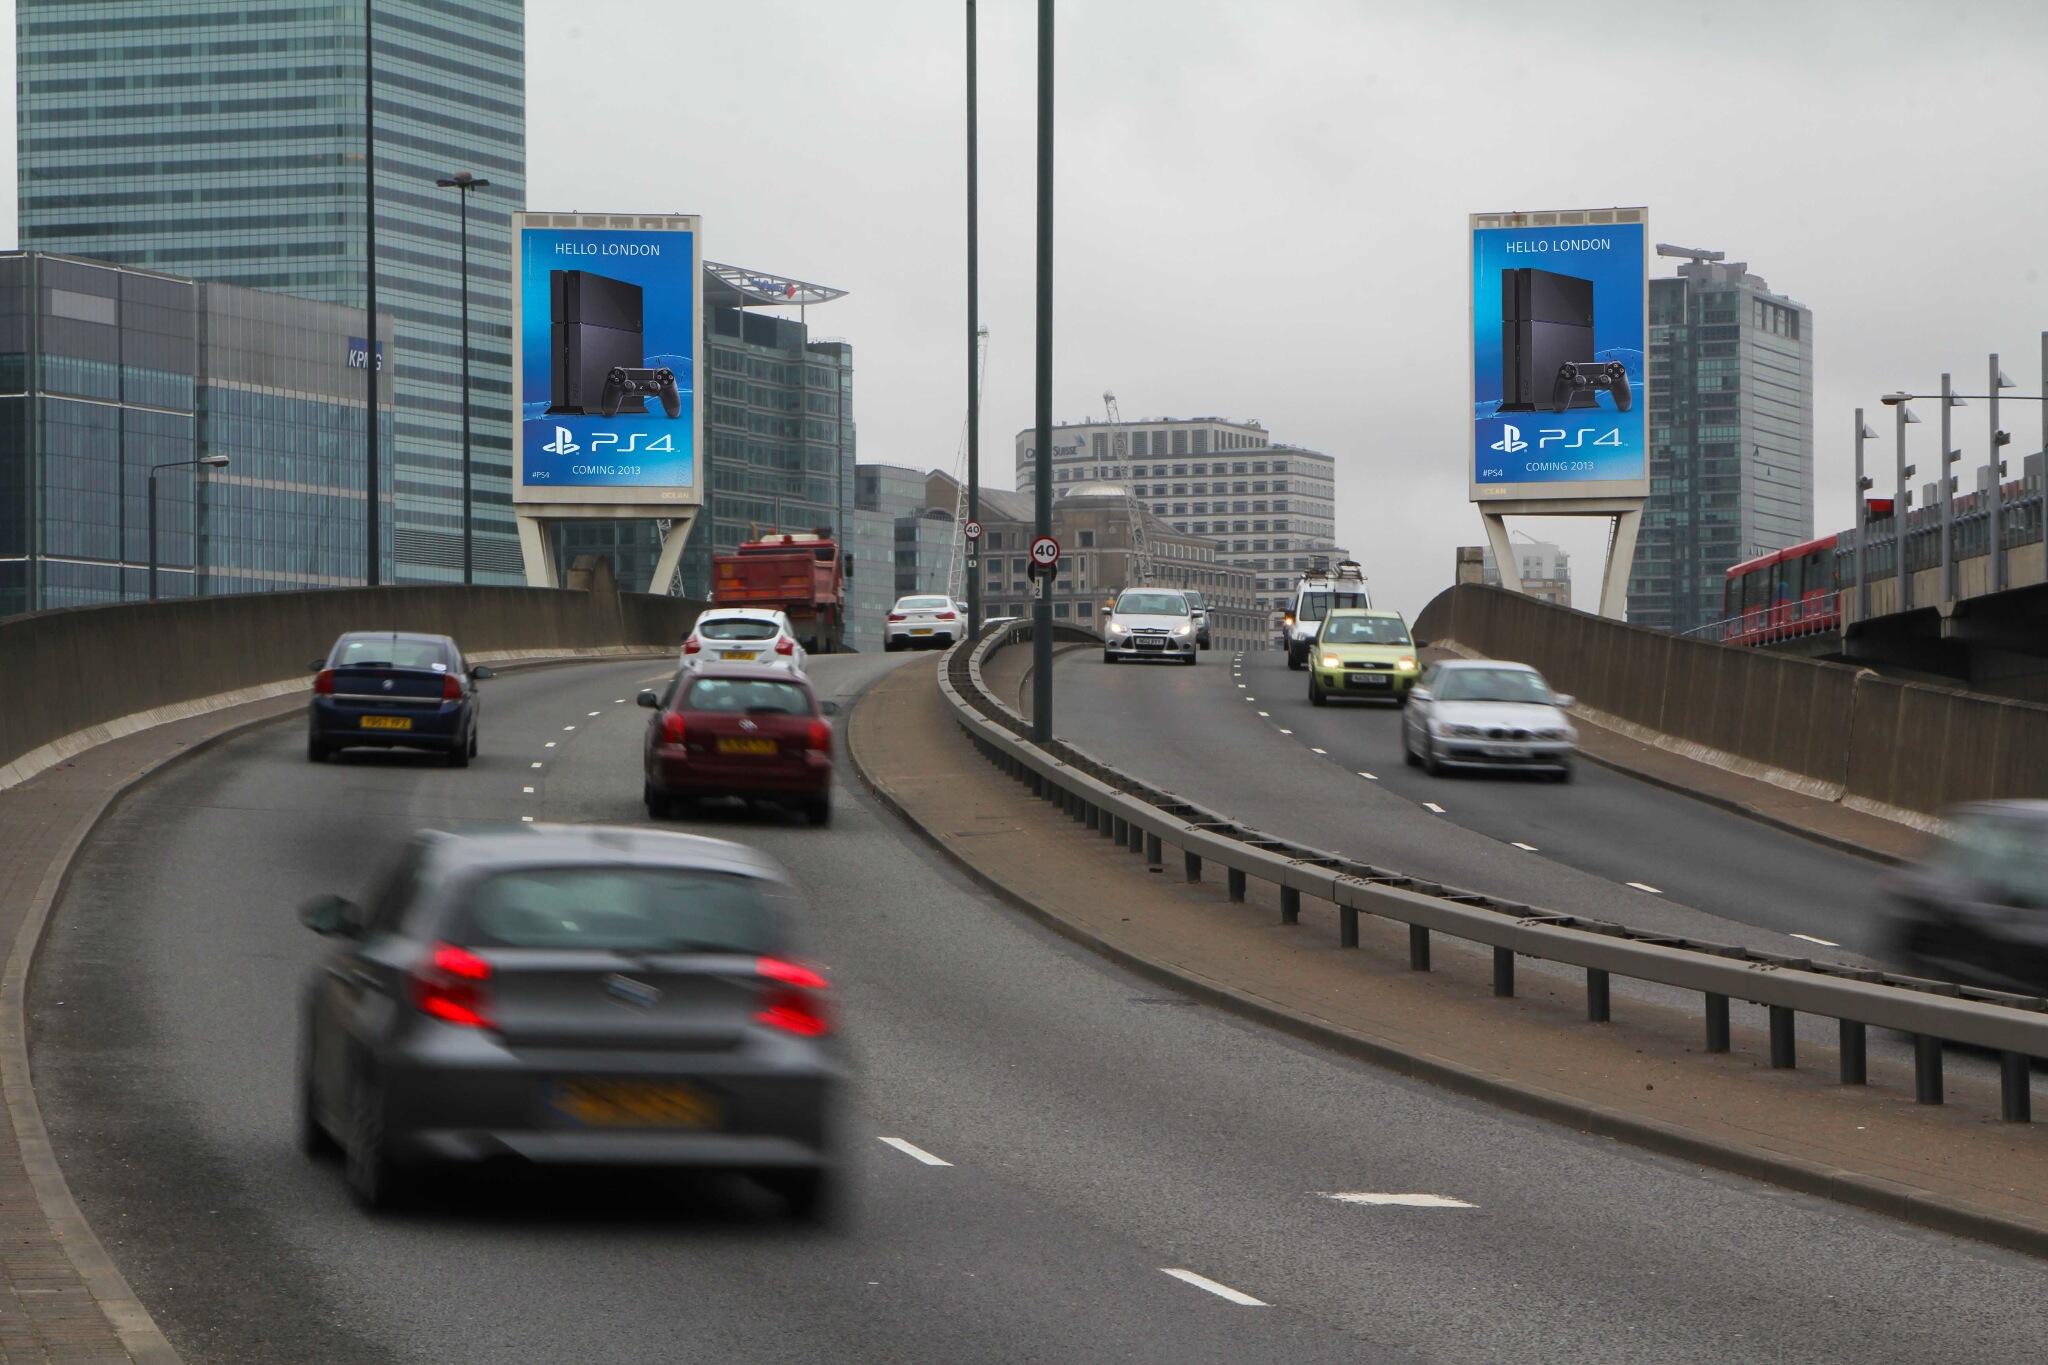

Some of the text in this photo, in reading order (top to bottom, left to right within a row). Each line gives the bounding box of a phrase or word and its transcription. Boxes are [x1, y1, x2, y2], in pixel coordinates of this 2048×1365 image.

[555, 243, 660, 256] HELLO LONDON
[1506, 238, 1610, 253] HELLO LONDON
[591, 432, 675, 453] PS4
[1539, 427, 1622, 449] PS4
[572, 465, 641, 475] COMING 2013
[1525, 461, 1594, 472] COMING 2013
[532, 471, 550, 479] #PS4
[1482, 469, 1503, 477] #PS4
[967, 525, 980, 534] 40
[1035, 544, 1056, 557] 40
